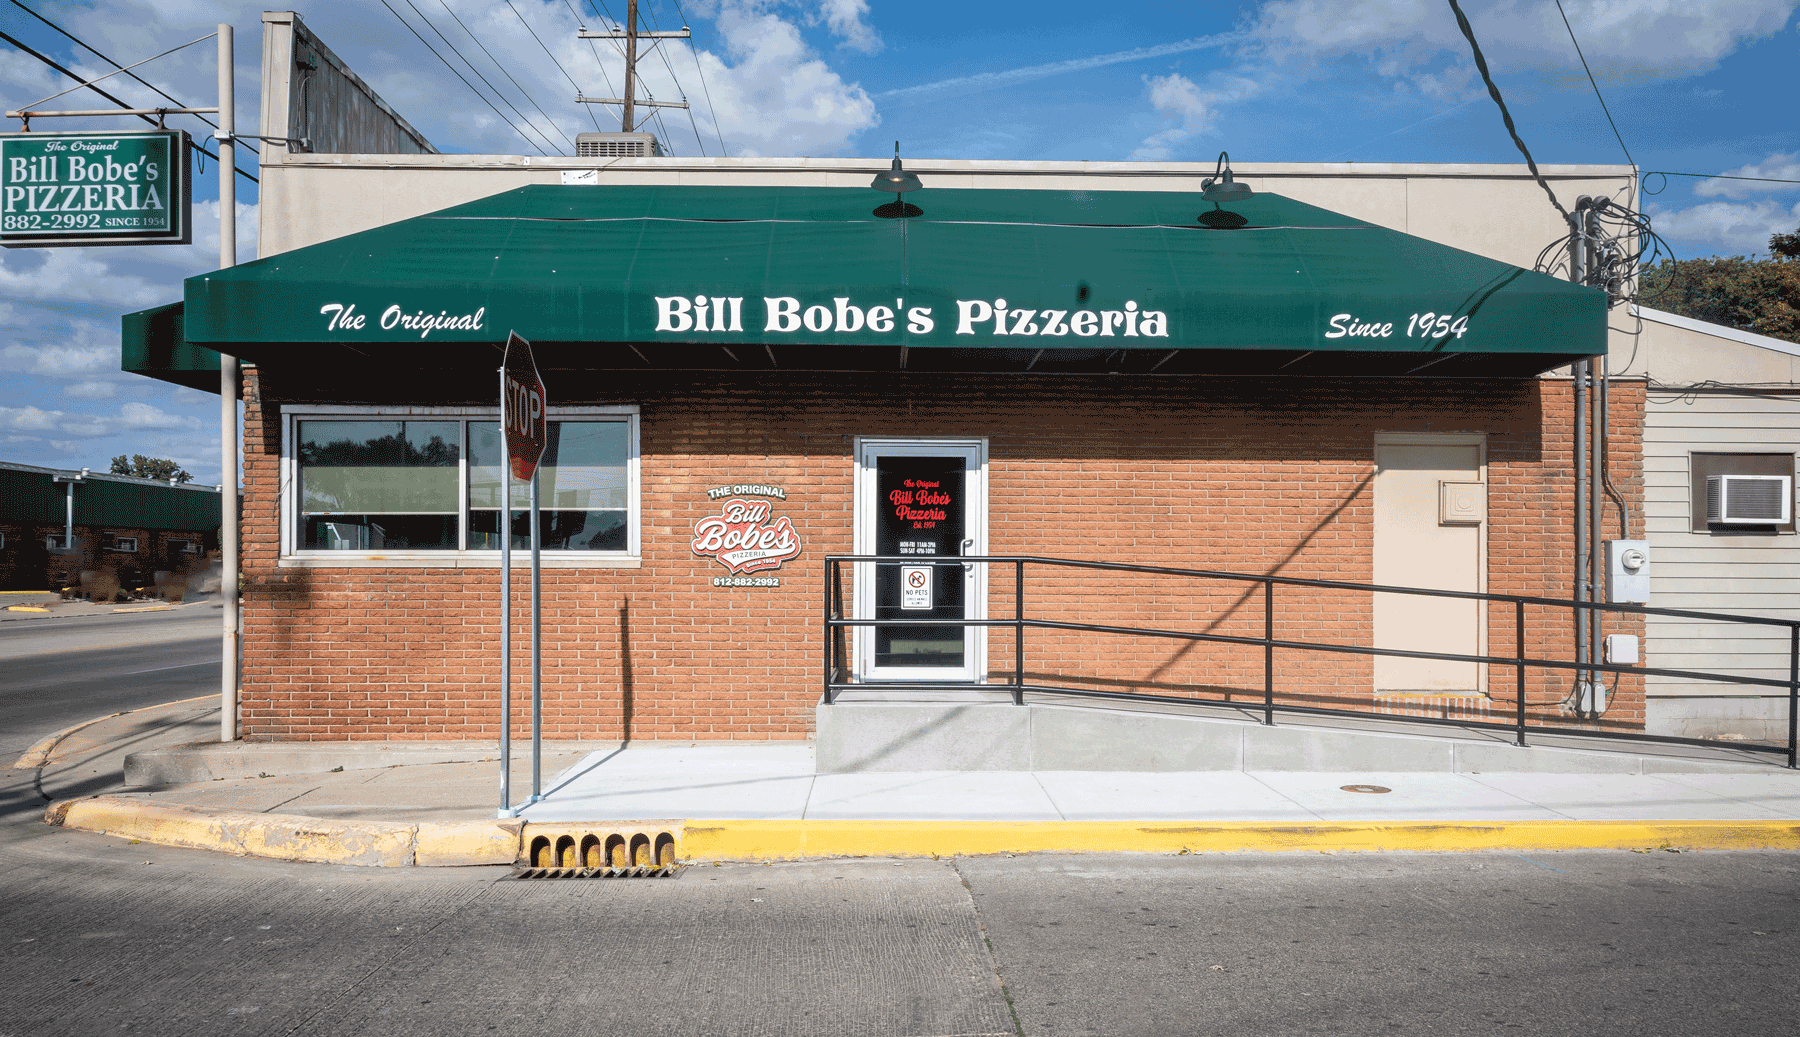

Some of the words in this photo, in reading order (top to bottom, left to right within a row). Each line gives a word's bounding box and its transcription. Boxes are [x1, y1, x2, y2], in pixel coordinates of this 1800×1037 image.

[45, 141, 68, 152] The
[70, 140, 119, 154] Original
[9, 155, 59, 183] Bill
[67, 154, 159, 182] Bobe's
[4, 183, 164, 212] PIZZERIA
[4, 213, 101, 230] 882-2992
[105, 217, 140, 227] SINCE
[142, 217, 165, 226] 1954
[320, 303, 366, 331] The
[380, 304, 485, 339] Original
[654, 295, 744, 332] Bill
[763, 296, 935, 334] Bobe's
[955, 298, 1169, 337] Pizzeria
[1324, 313, 1393, 338] Since
[1406, 312, 1469, 339] 1954
[505, 374, 542, 439] STOP
[708, 486, 732, 499] THE
[733, 485, 786, 499] ORIGINAL
[889, 490, 914, 505] Bill
[915, 490, 952, 505] Bobe's
[725, 503, 766, 523] Bill
[896, 505, 947, 520] Pizzeria
[696, 520, 795, 551] Bobe's
[732, 551, 767, 559] PIZZERIA
[713, 577, 780, 588] 812-882-2992
